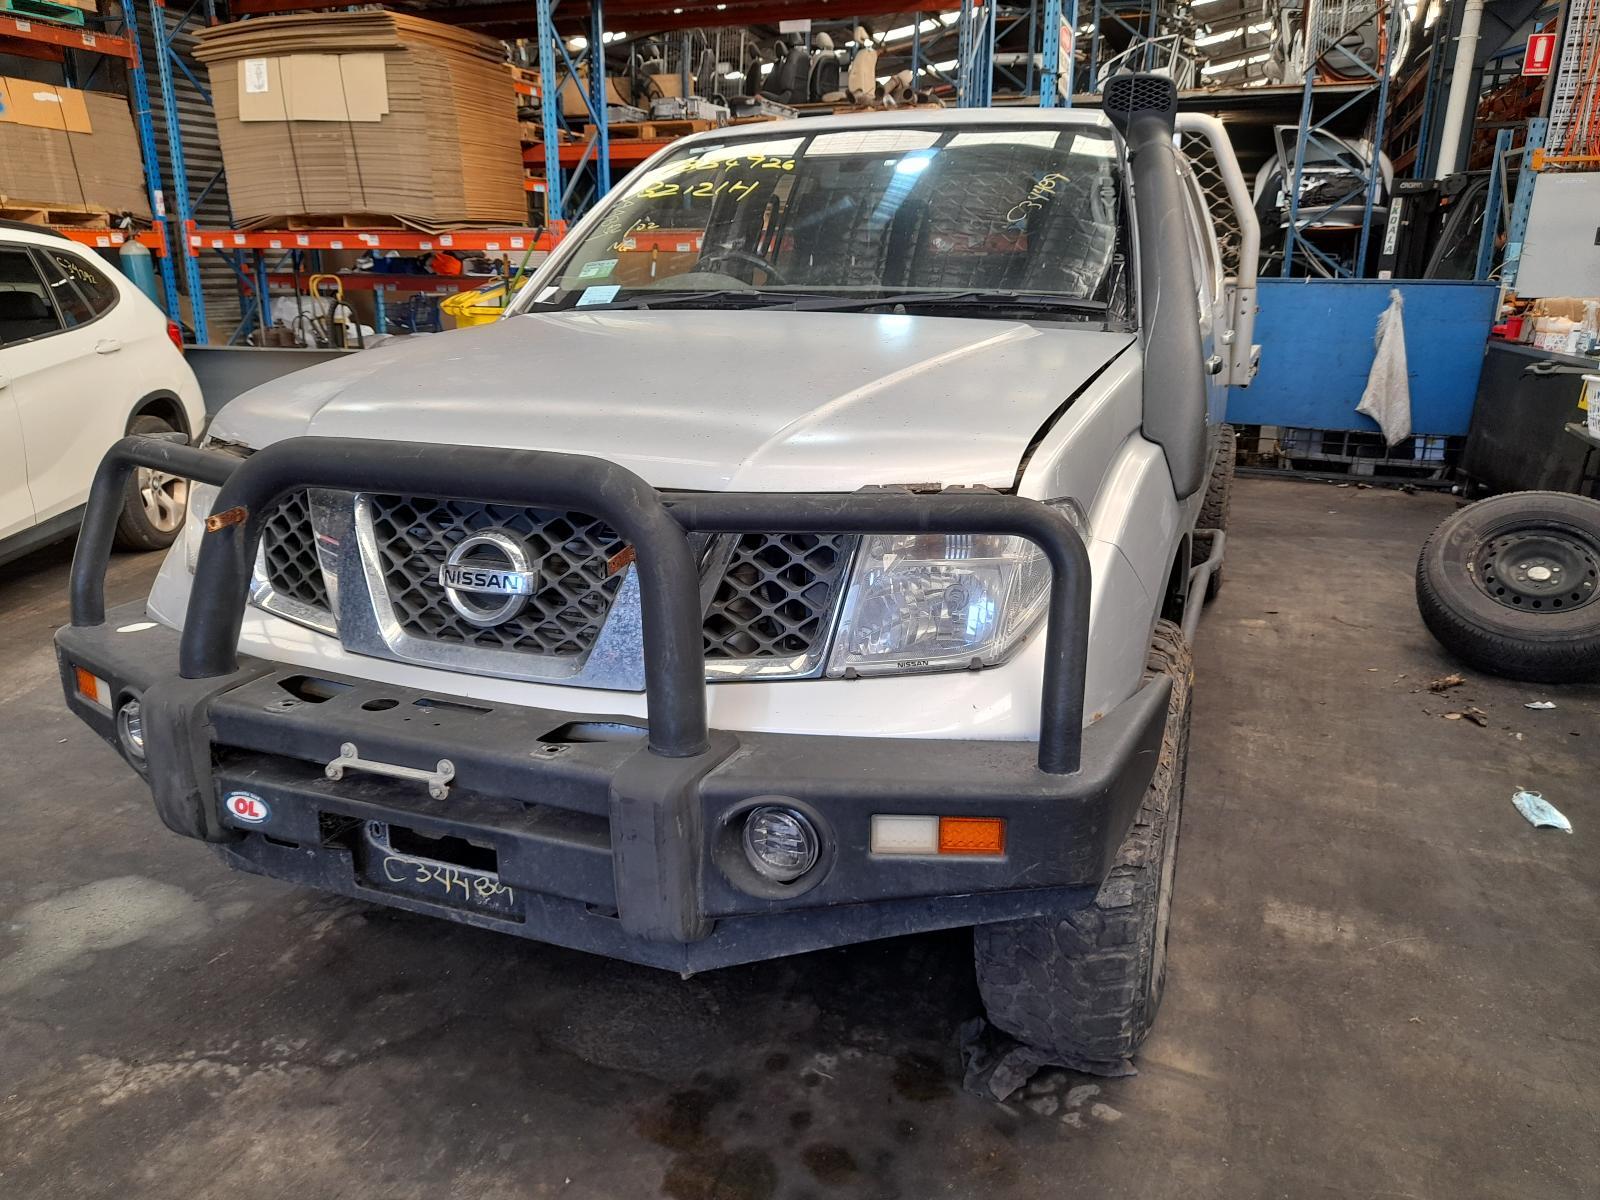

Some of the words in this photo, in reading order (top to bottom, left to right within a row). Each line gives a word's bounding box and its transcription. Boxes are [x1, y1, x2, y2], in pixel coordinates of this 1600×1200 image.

[444, 569, 519, 590] NISSAN
[897, 660, 929, 669] NISSAN
[234, 797, 260, 817] OL
[383, 856, 514, 907] C34489
